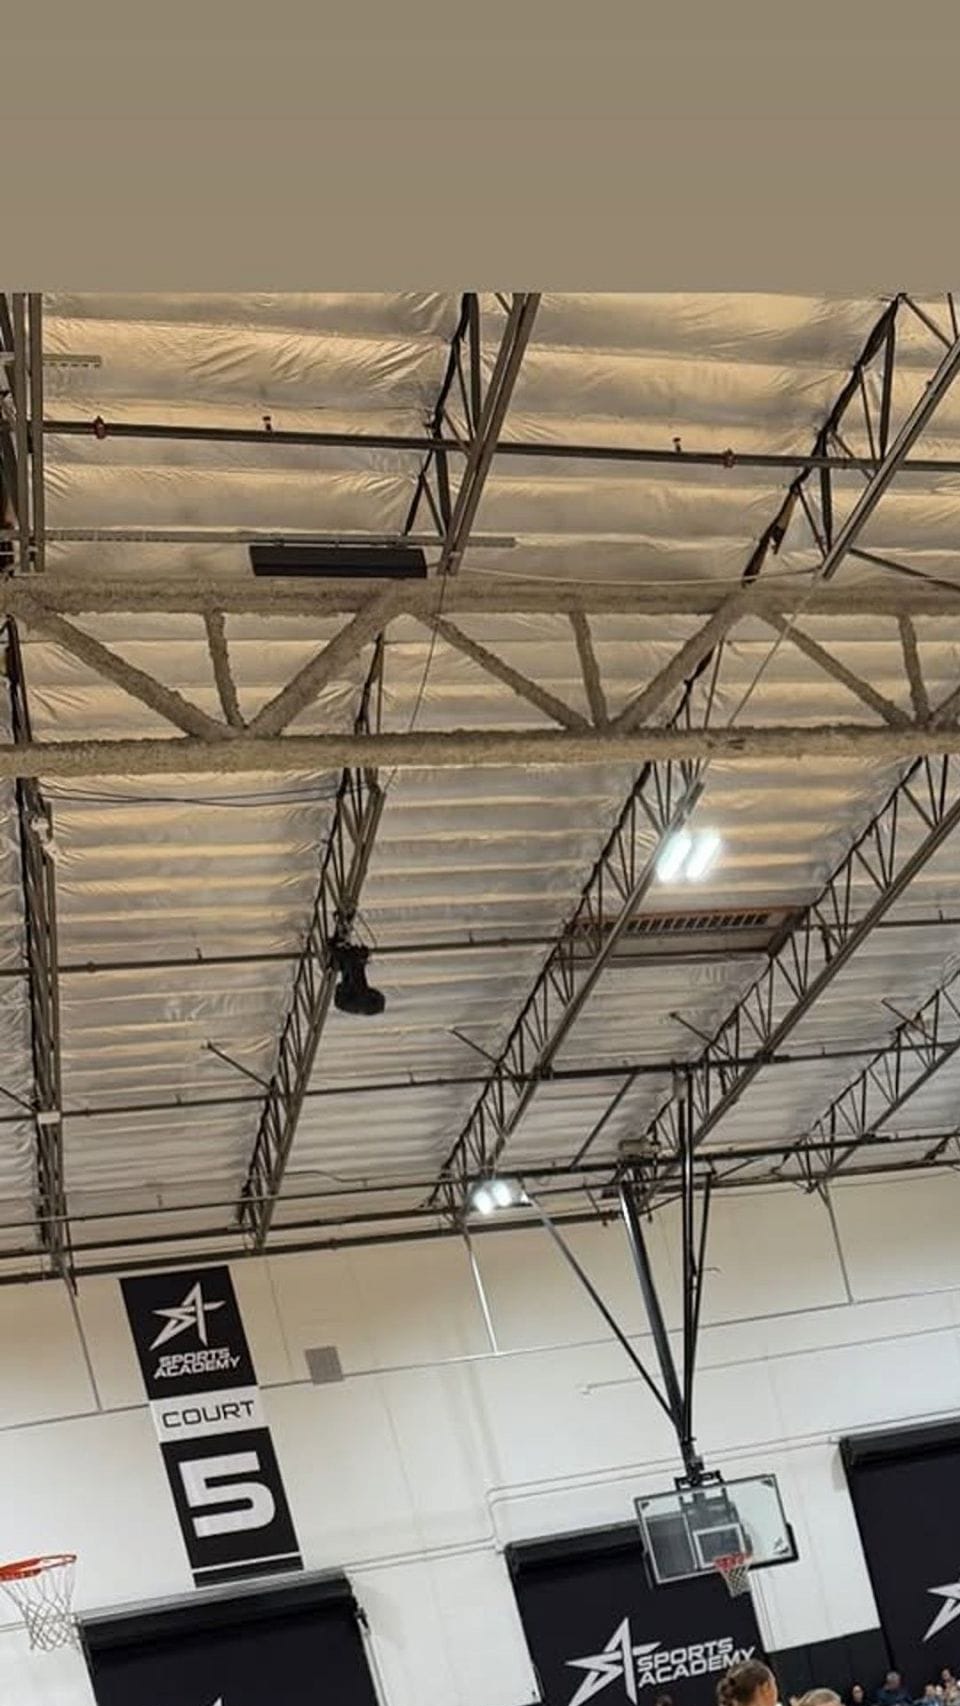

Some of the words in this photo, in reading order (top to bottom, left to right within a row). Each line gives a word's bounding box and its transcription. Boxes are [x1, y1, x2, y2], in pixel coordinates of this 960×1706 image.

[153, 1355, 241, 1380] ACADEMY
[158, 1347, 231, 1368] SPORTS
[162, 1400, 254, 1429] COURT
[178, 1450, 276, 1538] 5
[637, 1636, 734, 1673] SPORTS
[638, 1646, 756, 1688] ACADEMY
